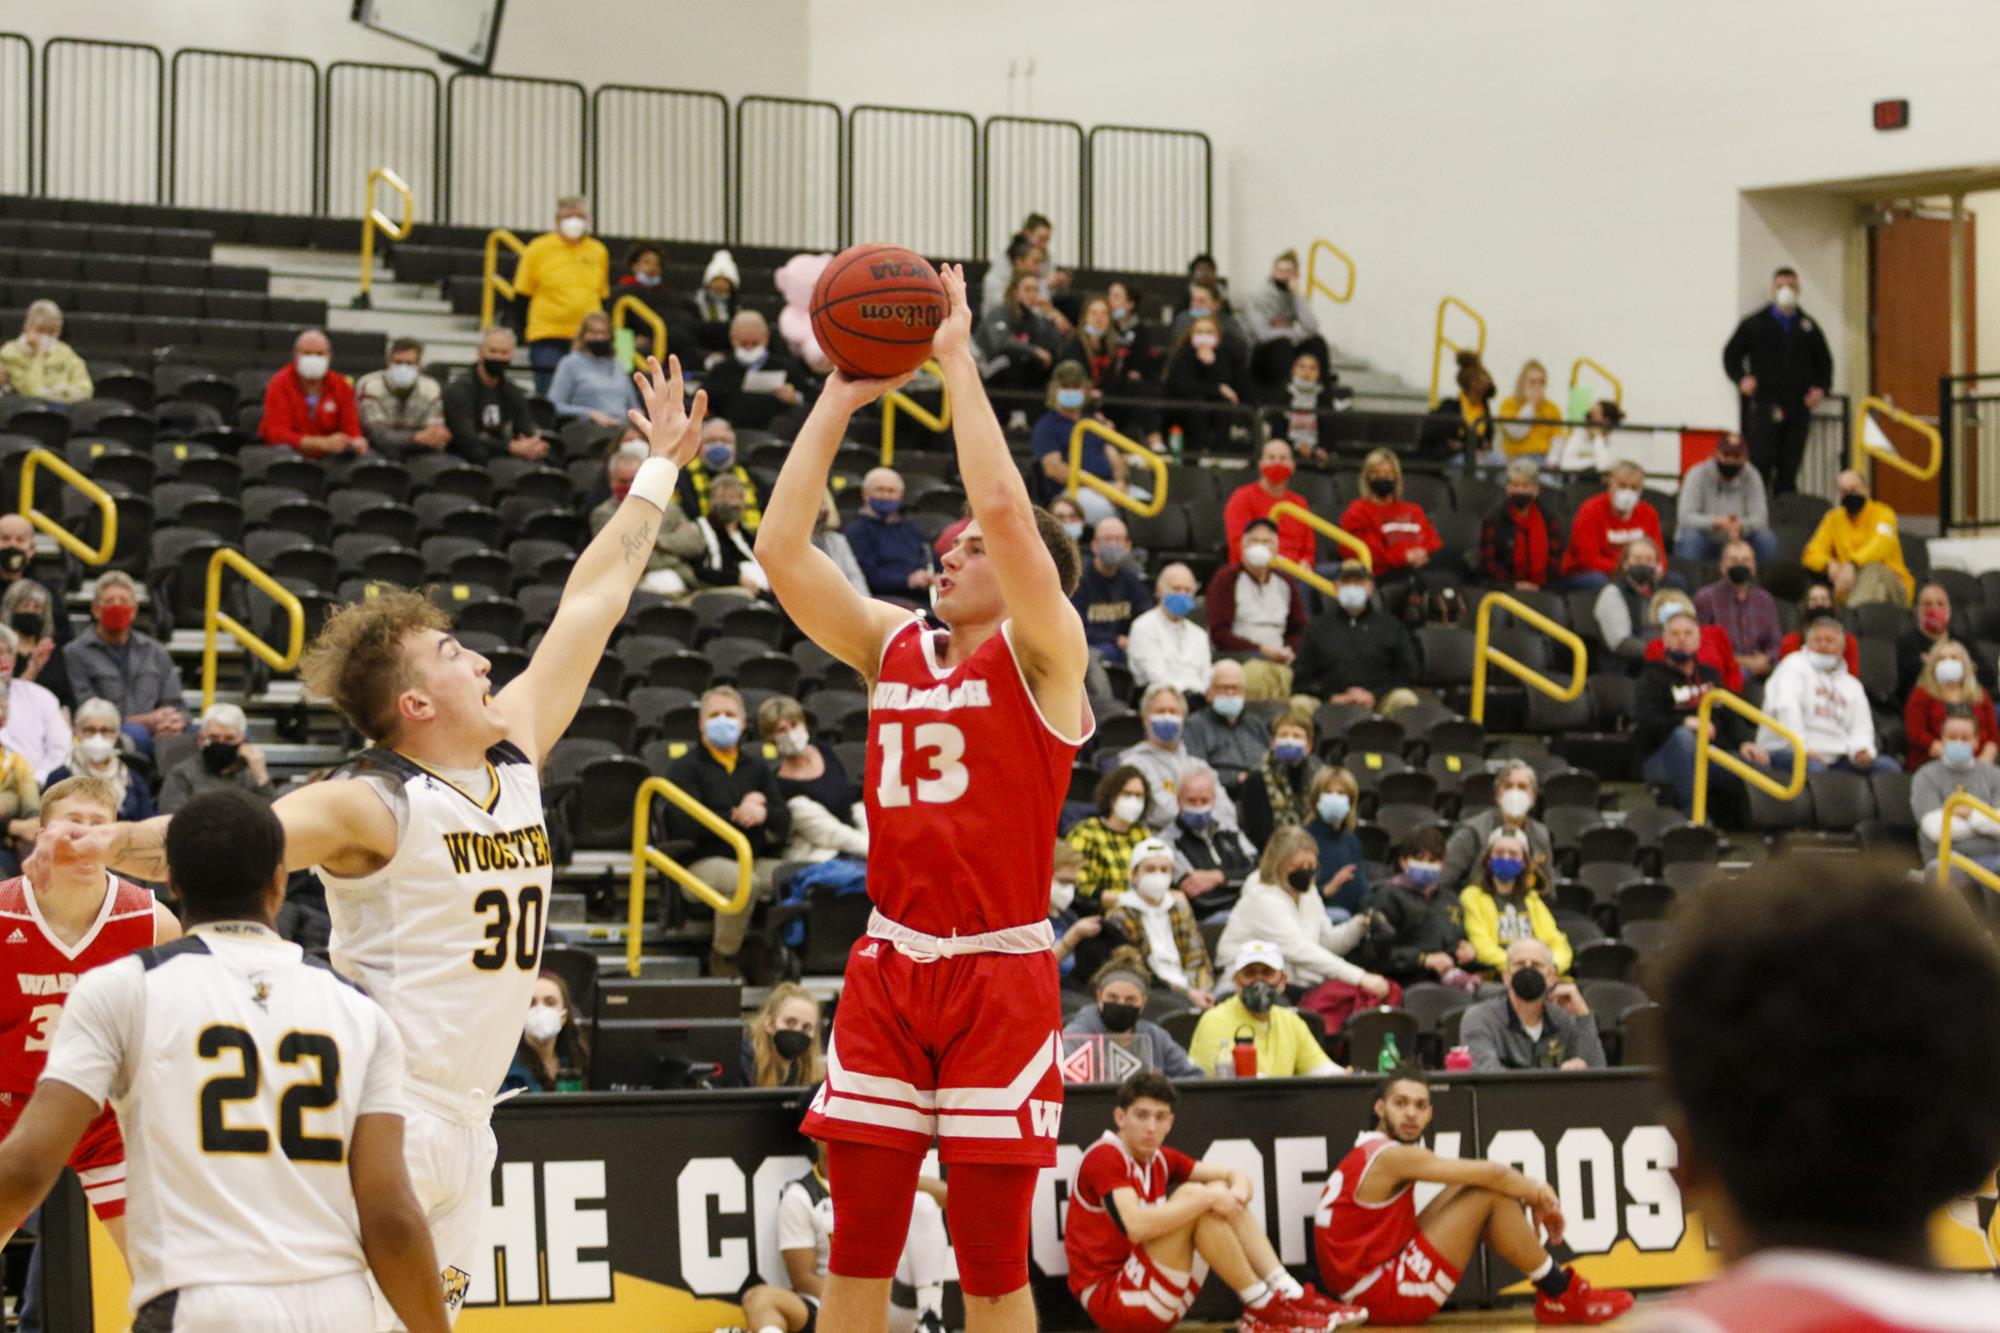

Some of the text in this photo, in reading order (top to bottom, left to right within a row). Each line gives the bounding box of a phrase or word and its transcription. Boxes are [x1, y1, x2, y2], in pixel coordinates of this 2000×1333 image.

[860, 303, 942, 328] Wilson
[877, 722, 969, 808] 13
[471, 884, 544, 973] 30
[17, 973, 79, 996] WAB
[196, 1022, 344, 1166] 22
[472, 1160, 612, 1303] HE
